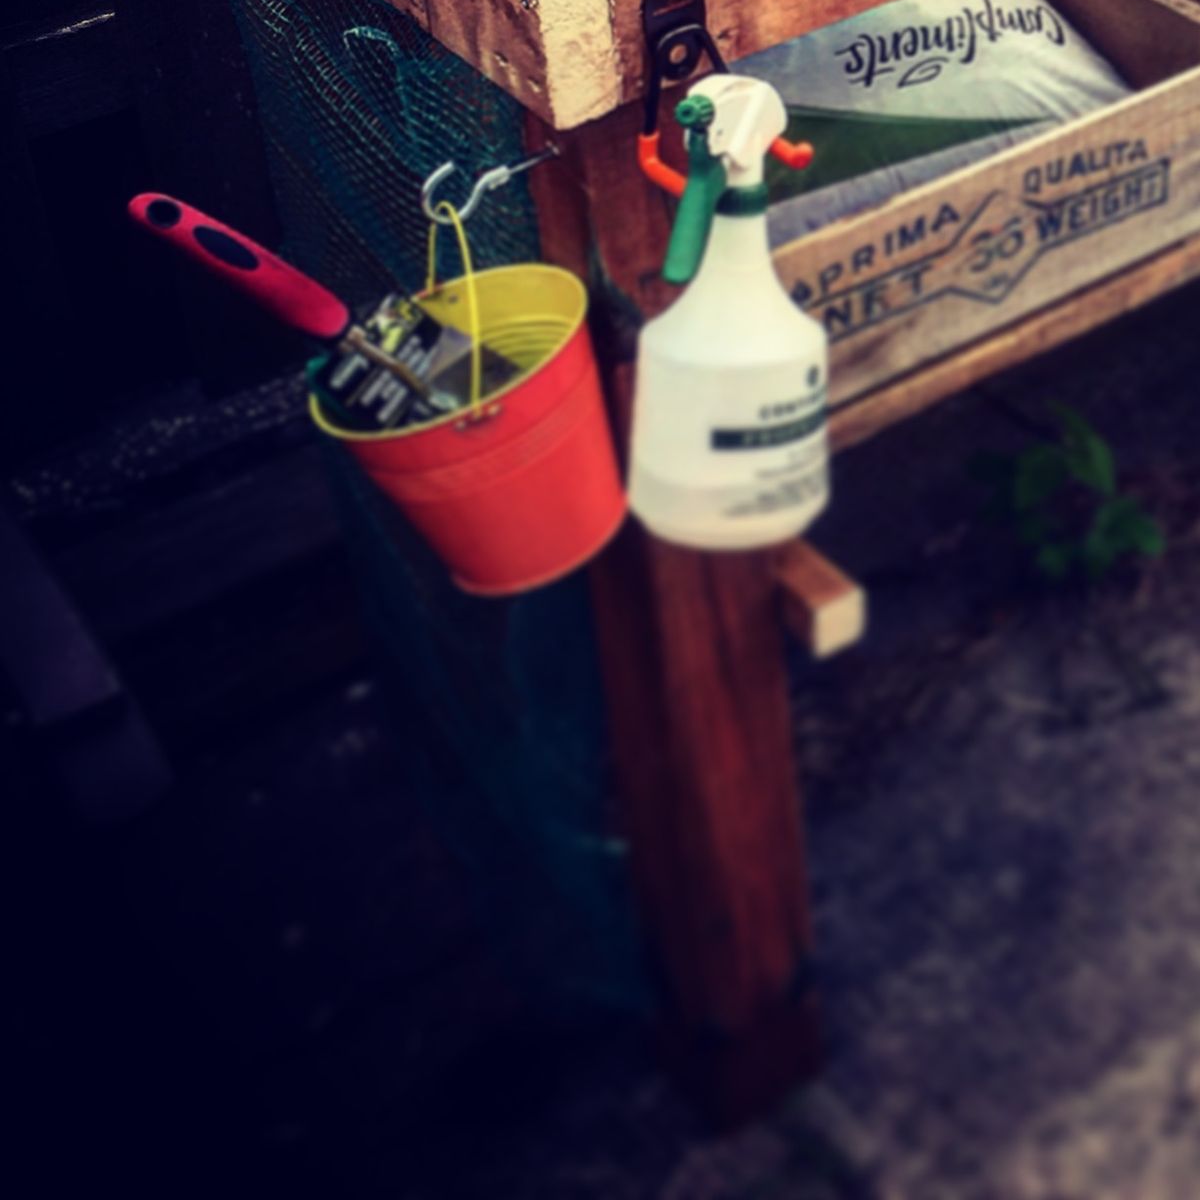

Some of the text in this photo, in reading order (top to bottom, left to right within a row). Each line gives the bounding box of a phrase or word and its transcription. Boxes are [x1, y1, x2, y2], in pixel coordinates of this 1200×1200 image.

[818, 138, 1149, 294] PRIMA QUALITA
[821, 263, 934, 334] NET
[1035, 171, 1163, 242] WEIGHT
